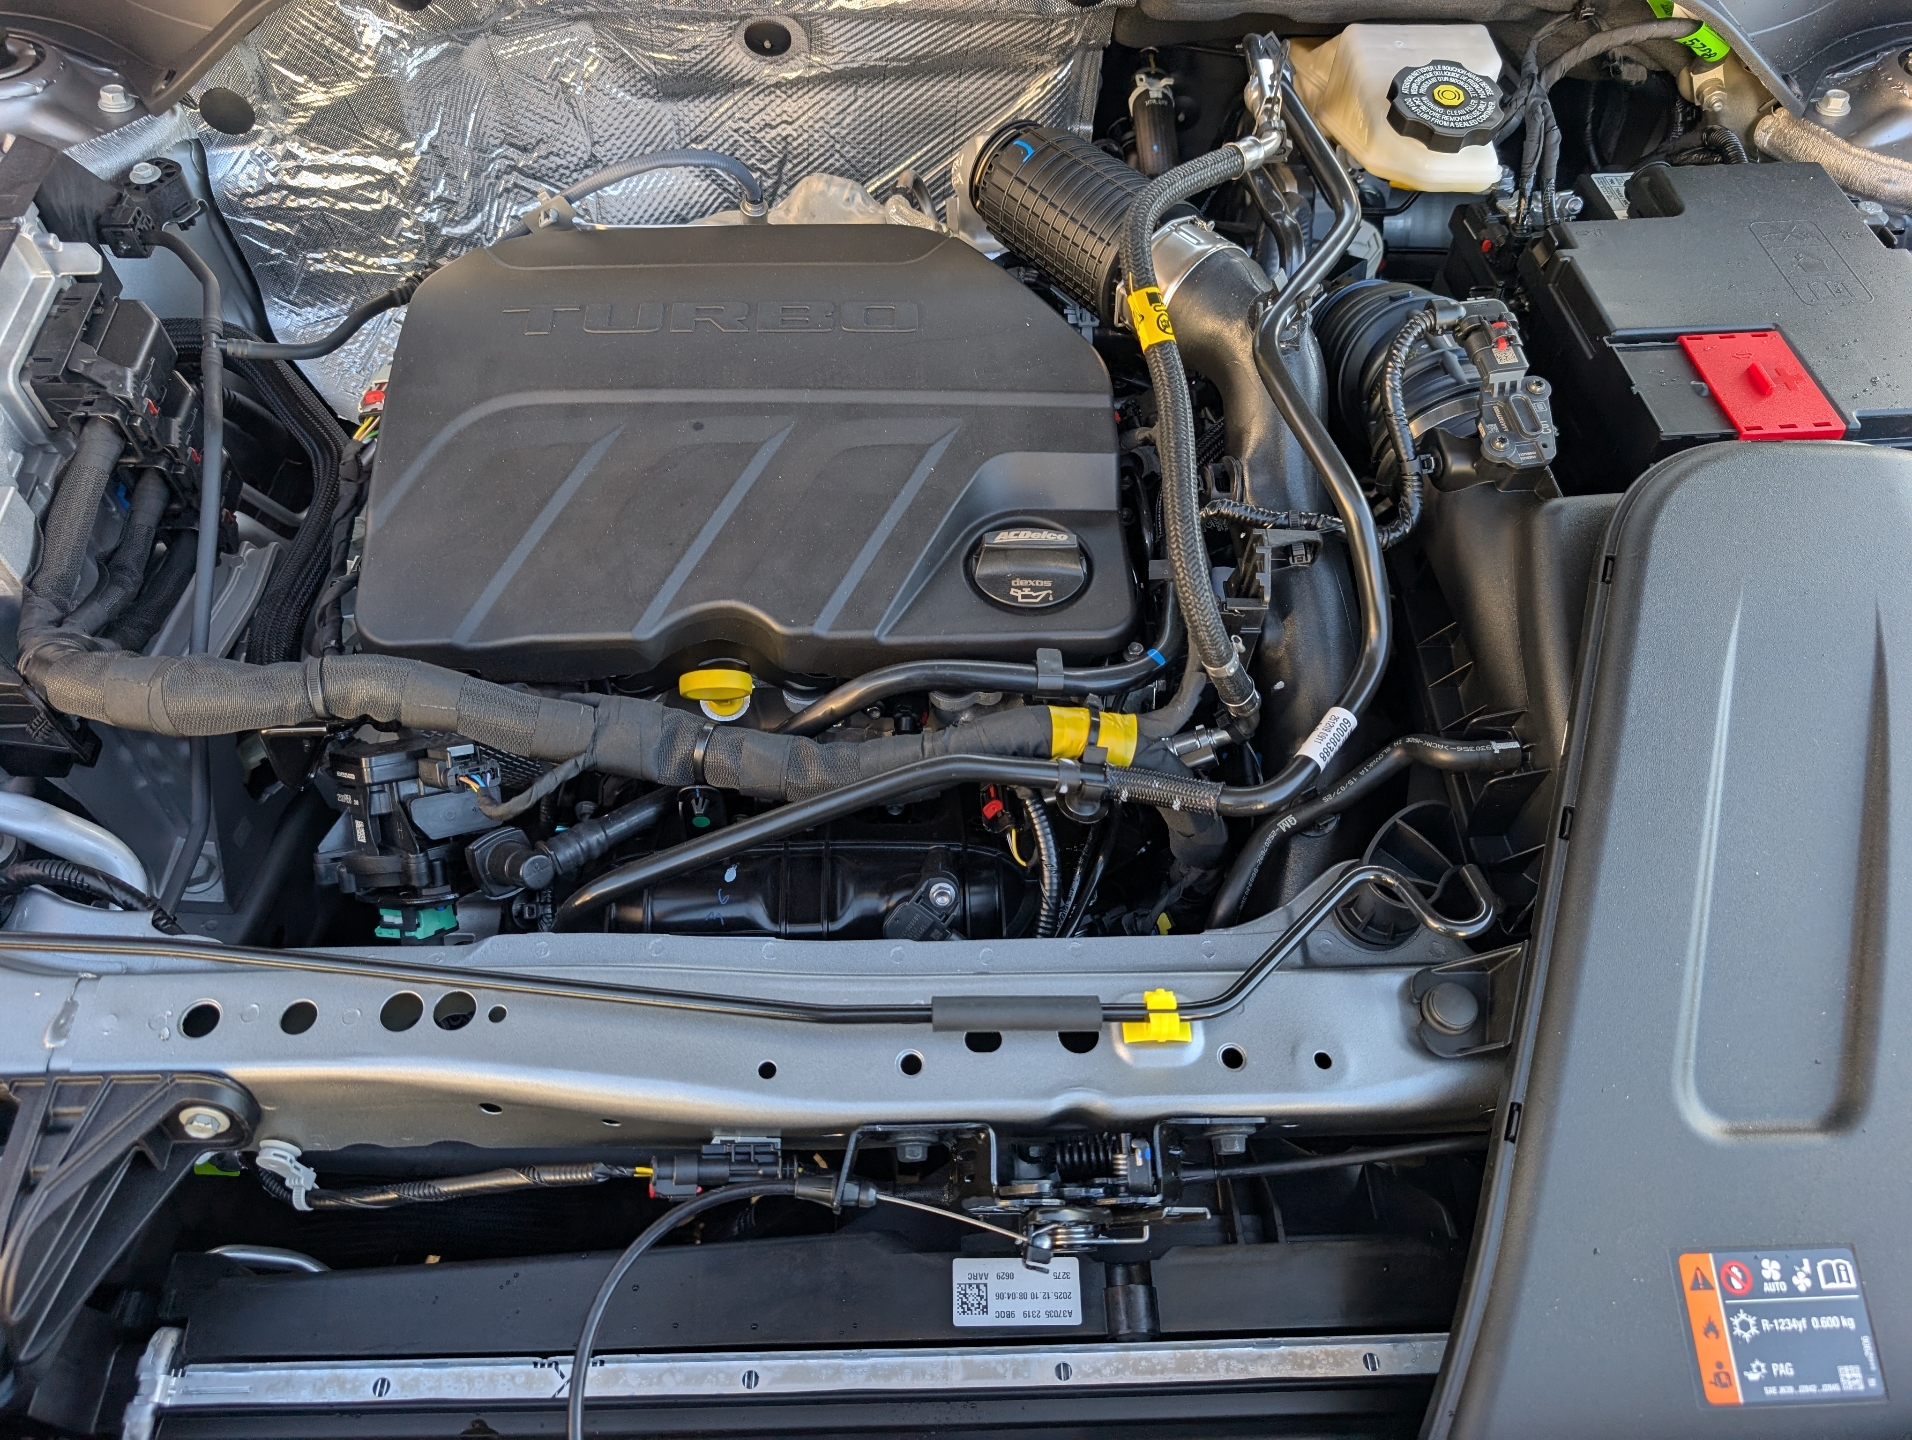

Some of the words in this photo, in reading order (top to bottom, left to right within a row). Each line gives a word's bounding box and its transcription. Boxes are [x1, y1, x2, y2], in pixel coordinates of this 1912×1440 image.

[502, 301, 918, 335] TURBO
[993, 530, 1069, 544] ACDelco
[1011, 578, 1053, 587] dexos
[1319, 717, 1352, 762] 60008388
[1359, 746, 1391, 776] SLOVAKIA
[1276, 814, 1298, 832] GM
[967, 1272, 989, 1280] AARC
[996, 1271, 1015, 1280] 0629
[1052, 1271, 1071, 1280] 3275
[1763, 1281, 1787, 1293] AUTO
[994, 1291, 1028, 1300] 08:04:06
[1030, 1291, 1072, 1300] 2025.12.10
[1022, 1310, 1041, 1319] 2319
[1044, 1309, 1073, 1319] A37035
[1760, 1317, 1808, 1333] R-1234yf
[1811, 1315, 1841, 1330] 0.600
[1840, 1315, 1857, 1331] kg
[1771, 1362, 1795, 1377] PAG
